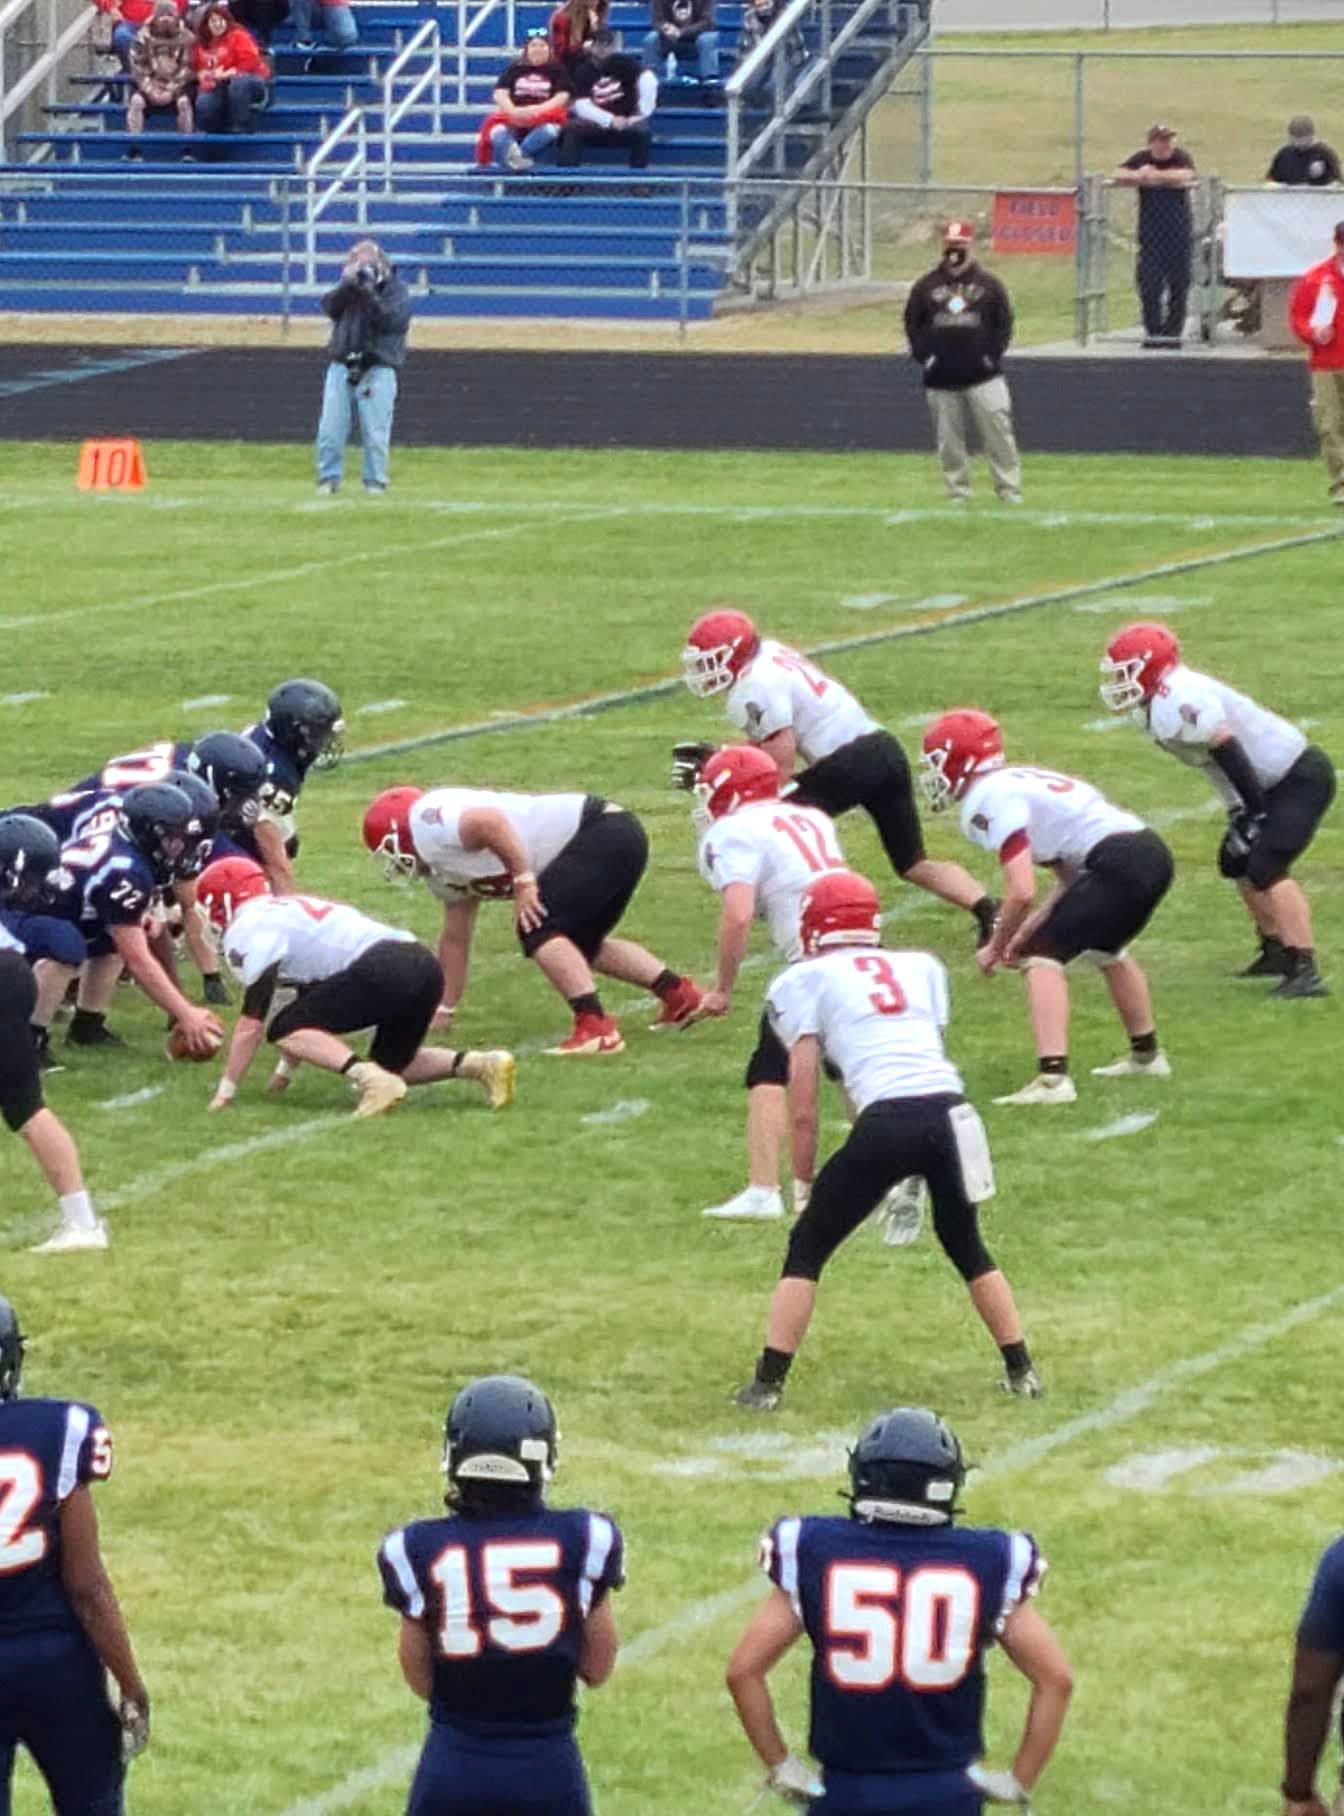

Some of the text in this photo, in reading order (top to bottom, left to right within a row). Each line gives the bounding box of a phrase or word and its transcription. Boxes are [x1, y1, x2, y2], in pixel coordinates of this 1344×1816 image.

[91, 447, 128, 487] 10
[851, 955, 909, 1016] 3
[430, 1541, 565, 1657] 15
[826, 1560, 979, 1690] 50
